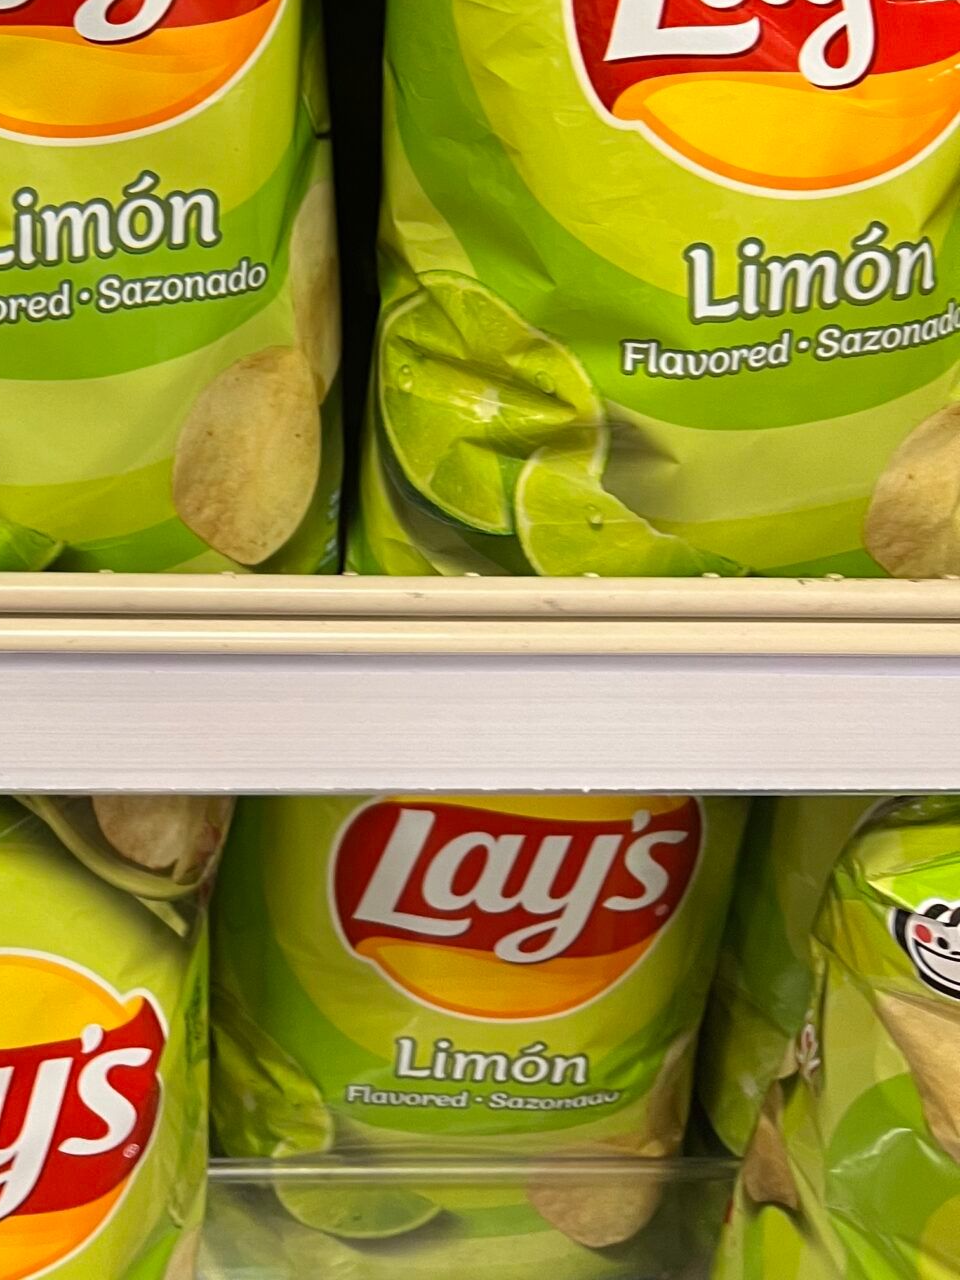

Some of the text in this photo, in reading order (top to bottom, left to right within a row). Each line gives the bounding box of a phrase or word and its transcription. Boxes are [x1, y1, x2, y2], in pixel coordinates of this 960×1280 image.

[97, 258, 269, 312] Sazonado
[686, 222, 937, 322] Limón
[622, 330, 792, 378] Flavored
[351, 809, 690, 963] Lay's
[394, 1036, 589, 1086] Limón
[345, 1083, 470, 1109] Flavored
